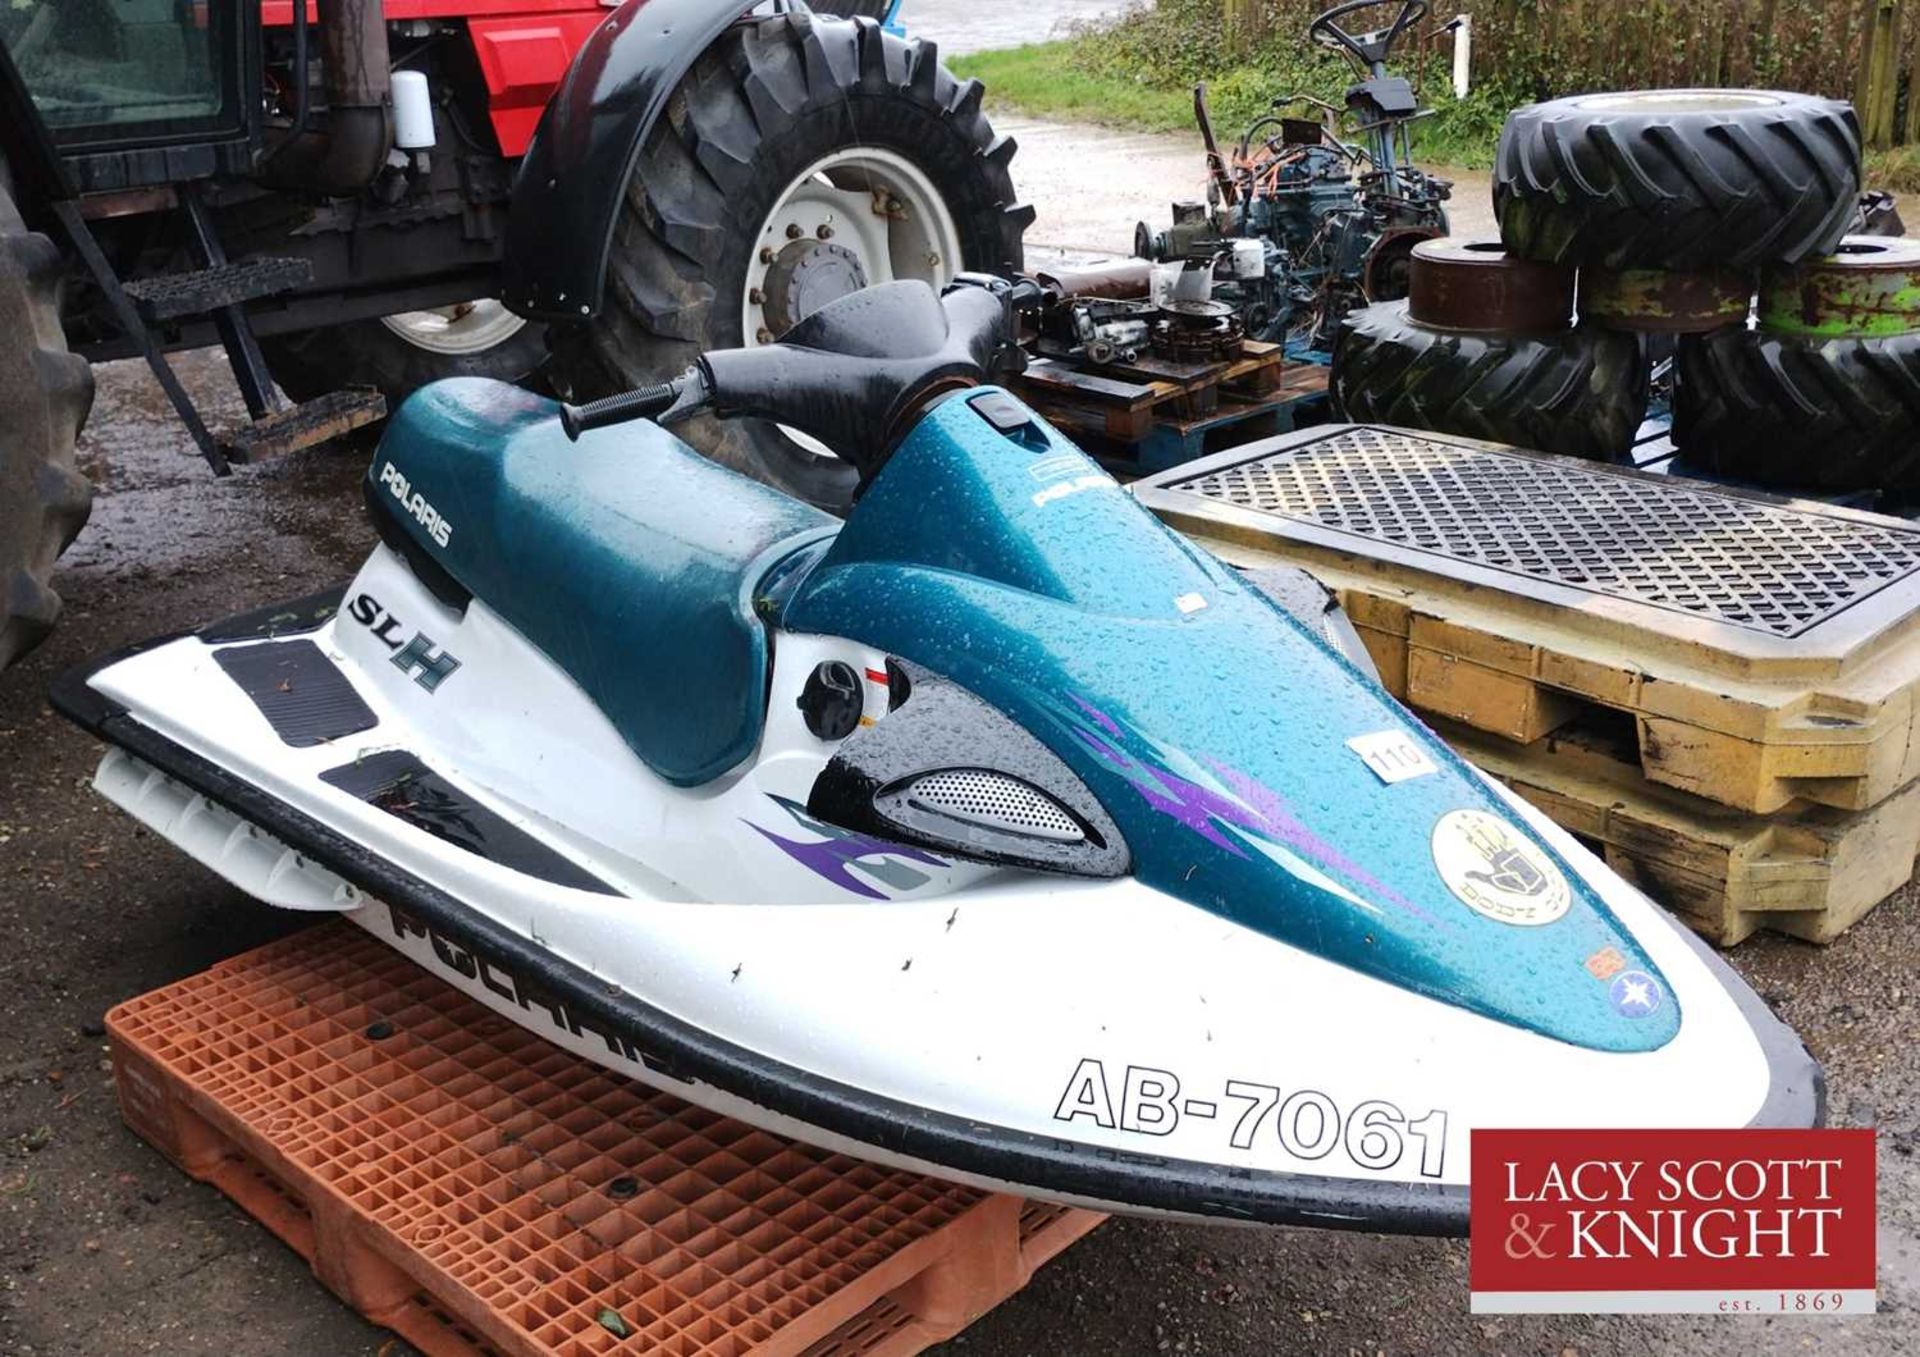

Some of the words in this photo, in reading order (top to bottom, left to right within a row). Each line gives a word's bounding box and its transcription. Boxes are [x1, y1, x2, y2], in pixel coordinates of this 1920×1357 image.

[379, 461, 452, 549] POLARIS
[346, 594, 462, 696] SLH
[1367, 743, 1422, 771] 110
[1052, 1057, 1449, 1178] AB-7061
